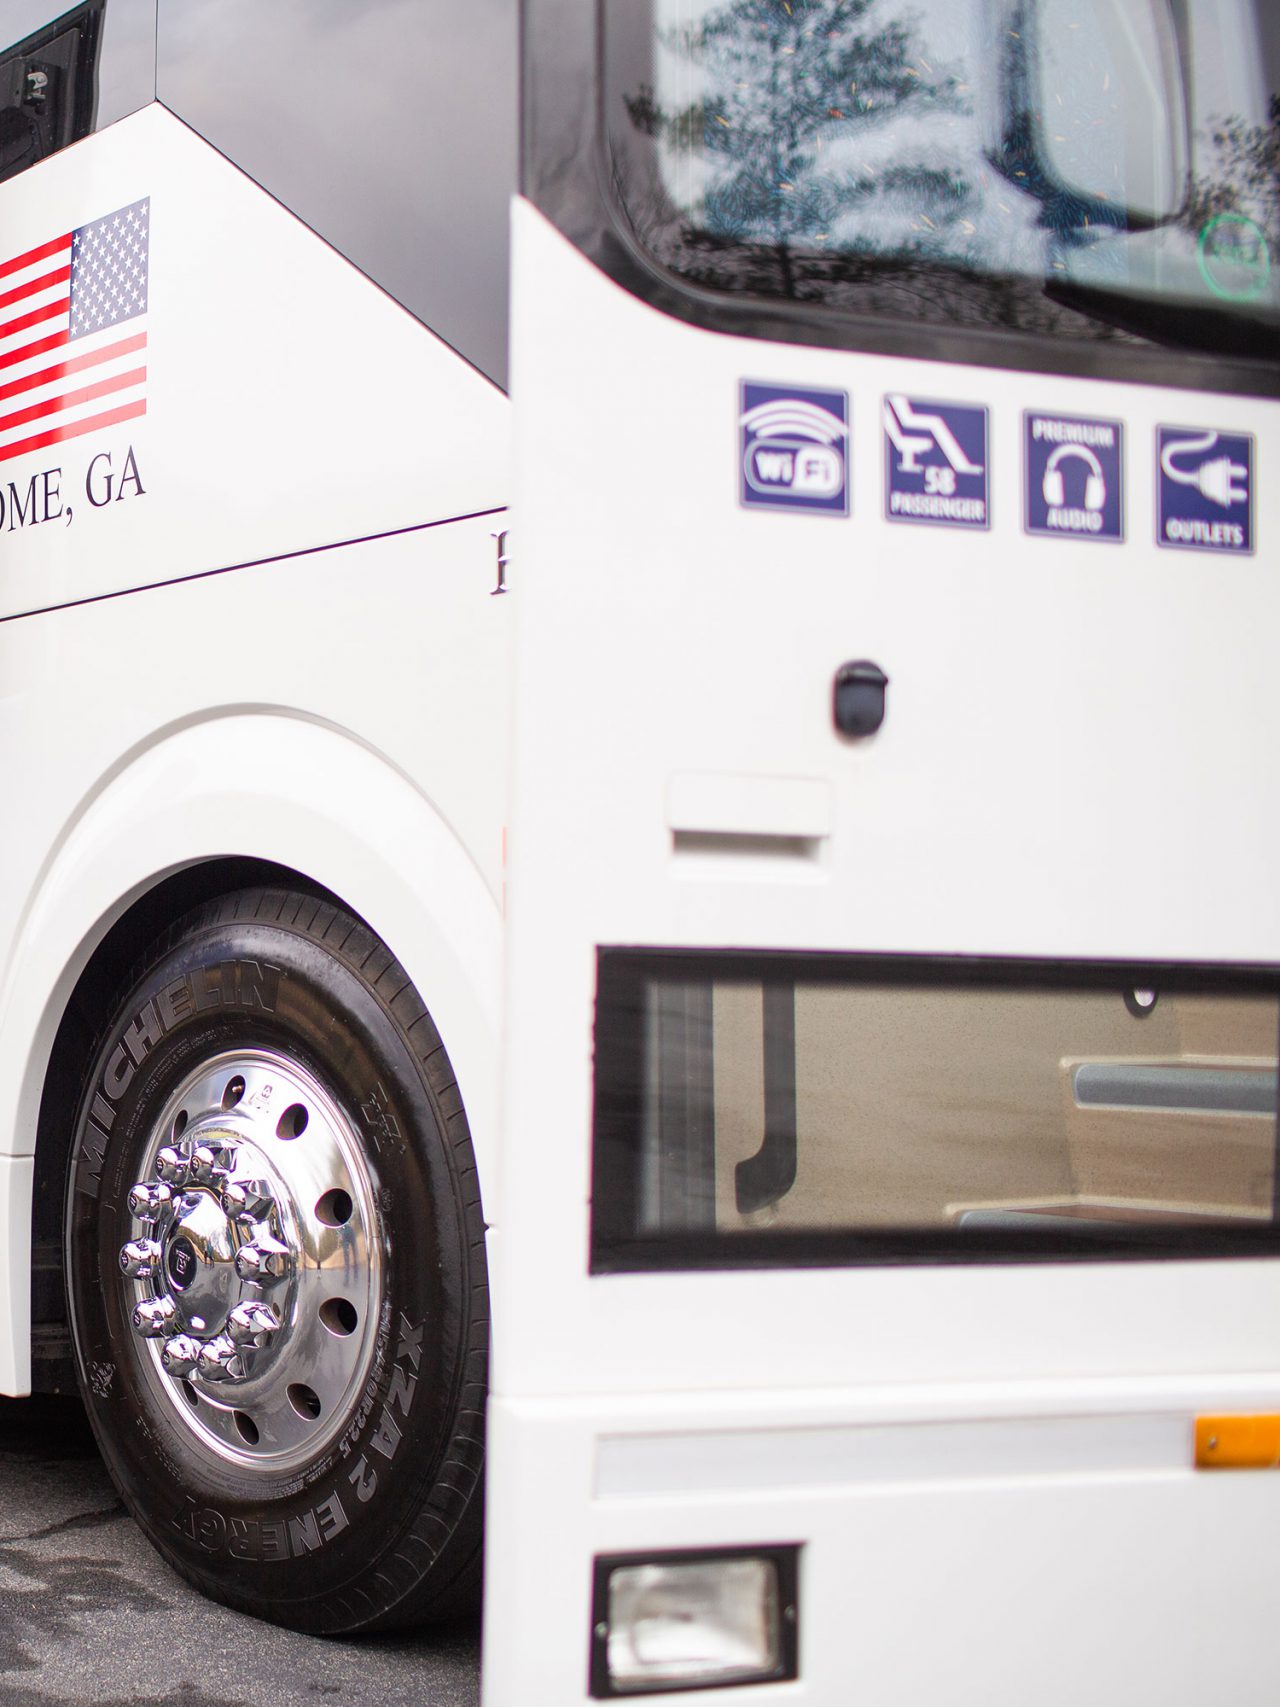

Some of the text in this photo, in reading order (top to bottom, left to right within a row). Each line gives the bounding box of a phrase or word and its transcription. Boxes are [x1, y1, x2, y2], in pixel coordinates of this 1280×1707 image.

[1032, 418, 1114, 449] PREMIUM
[85, 444, 147, 507] GA
[891, 491, 985, 521] PASSENGER
[1046, 506, 1104, 532] AUDIO
[1165, 517, 1244, 546] OUTLETS
[75, 959, 281, 1198] MICHELIN
[369, 1311, 426, 1461] XZA
[348, 1453, 378, 1503] 2
[170, 1489, 350, 1562] ENERGY
